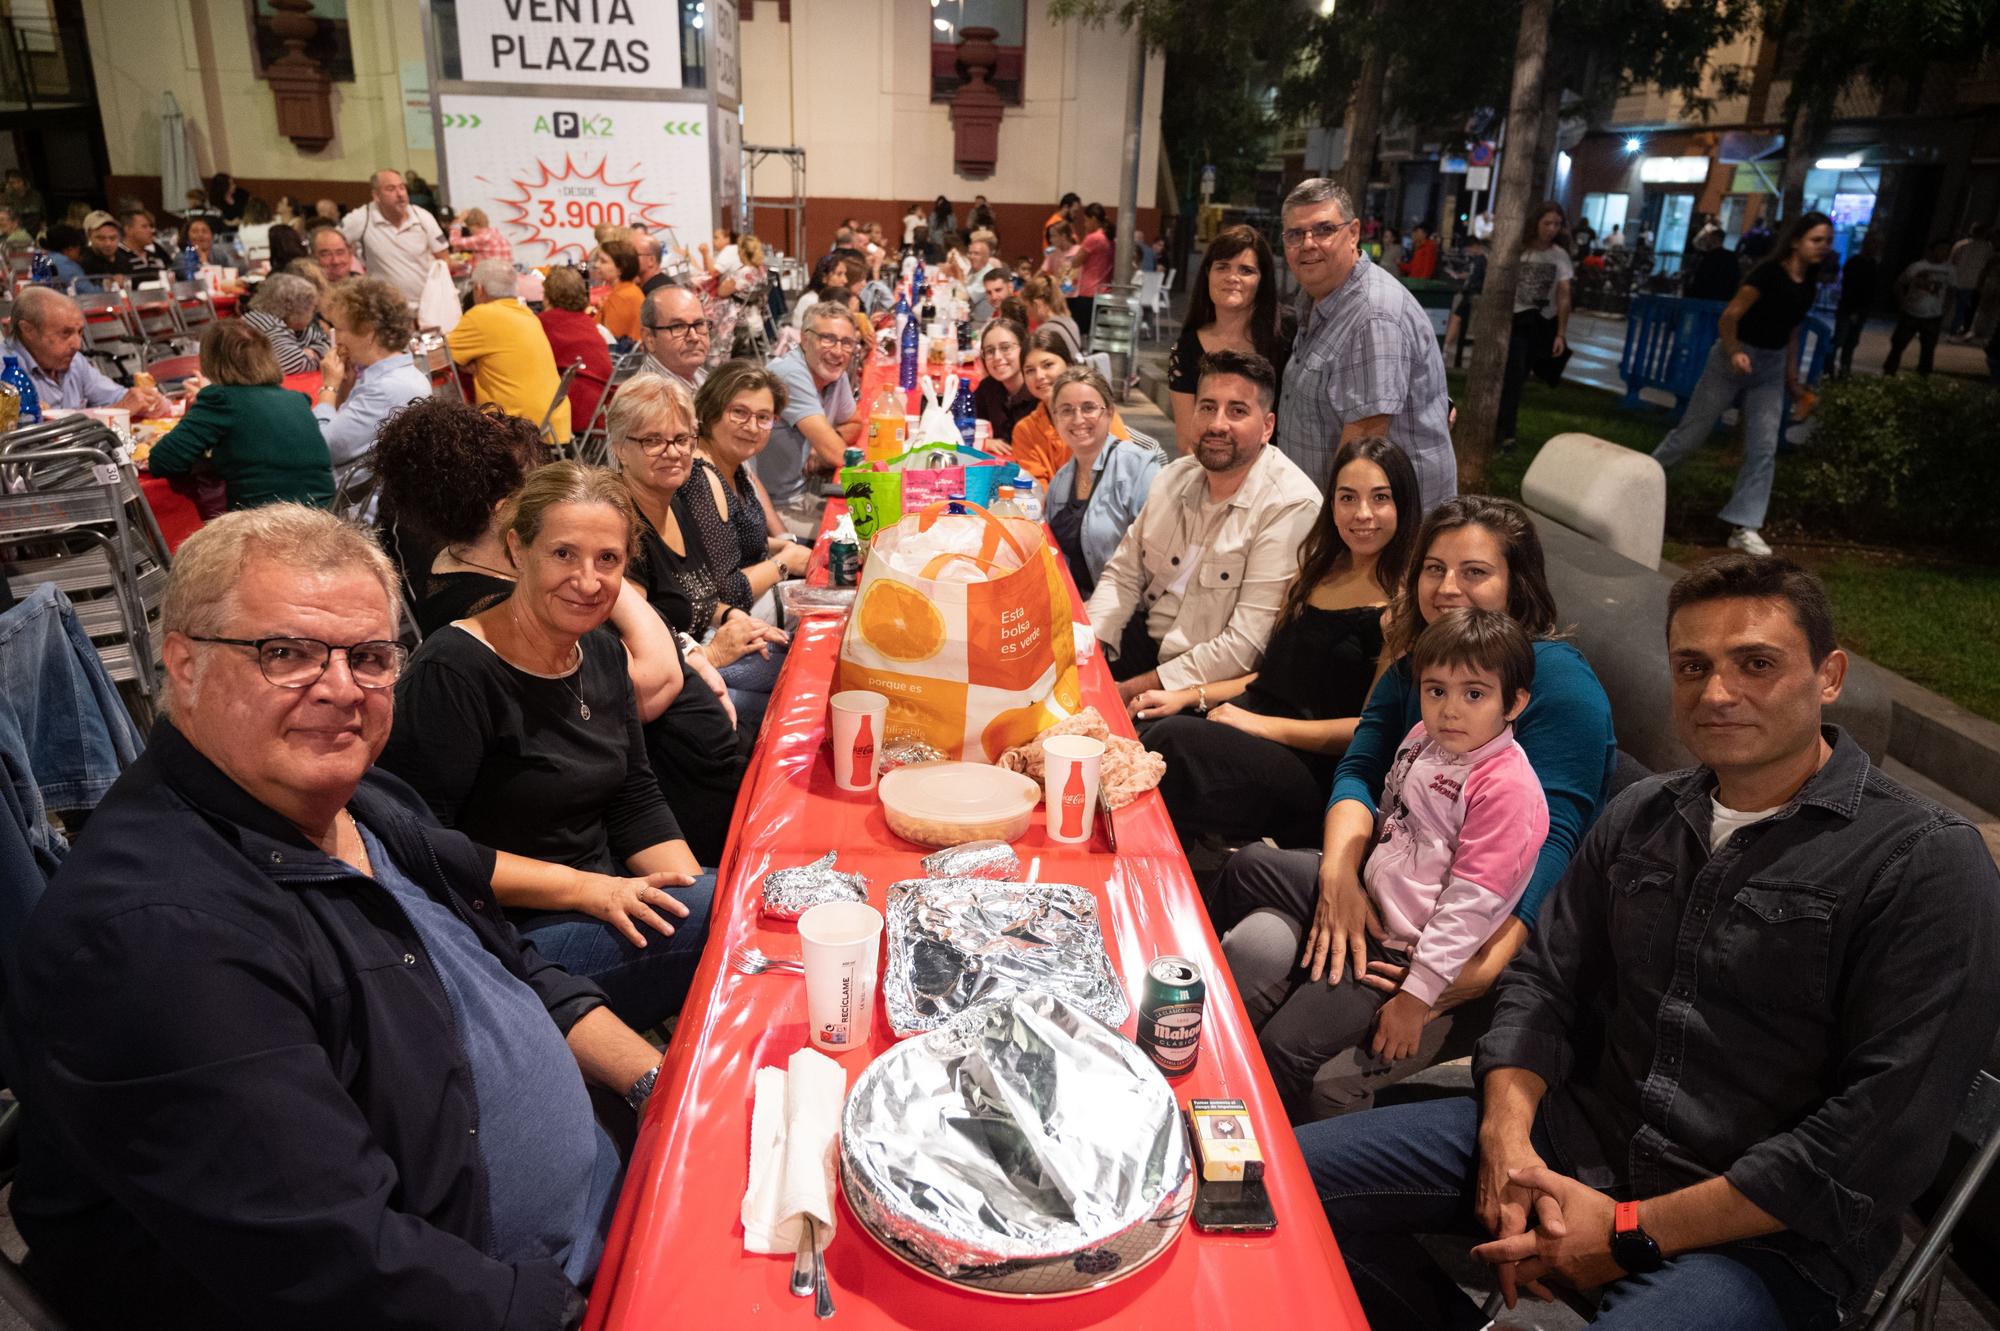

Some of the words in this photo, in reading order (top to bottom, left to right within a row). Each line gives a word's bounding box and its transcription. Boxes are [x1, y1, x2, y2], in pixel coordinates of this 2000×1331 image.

[505, 0, 634, 25] VENTA
[491, 35, 650, 73] PLAZAS
[538, 199, 625, 229] 3.900
[1001, 606, 1024, 624] Esta
[1001, 620, 1031, 639] bolsa
[1001, 642, 1017, 654] es
[1020, 627, 1041, 650] verde
[868, 677, 907, 692] porque
[909, 685, 923, 694] es
